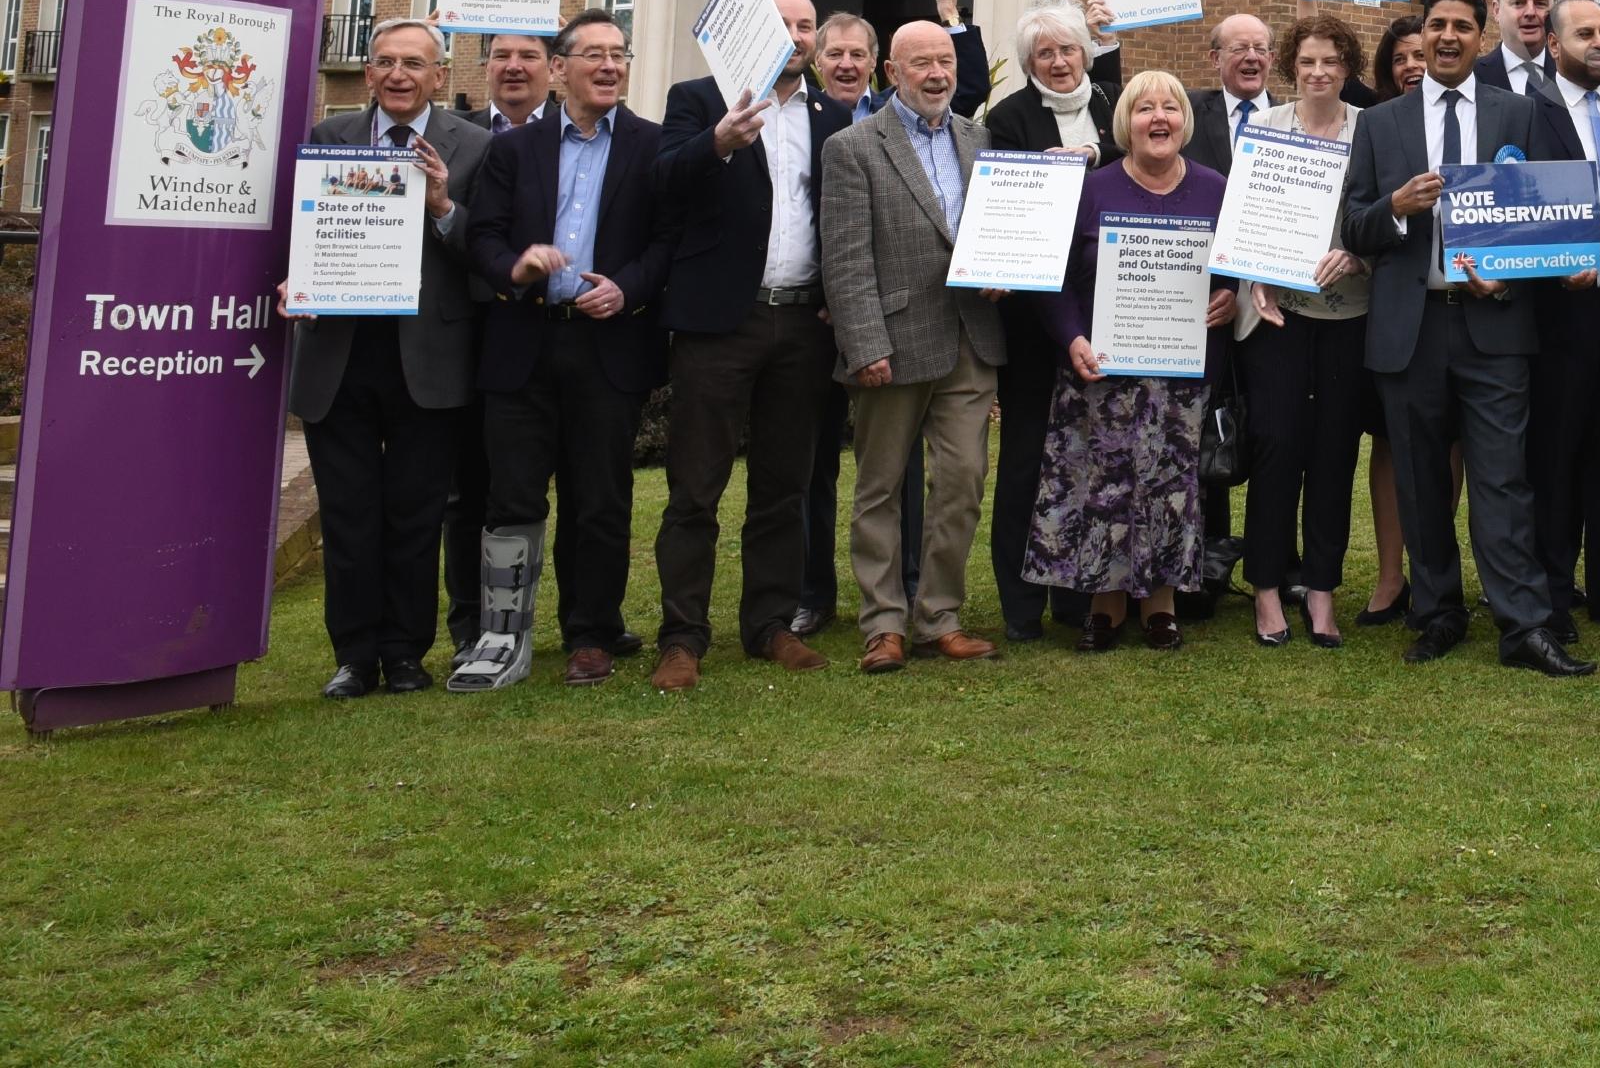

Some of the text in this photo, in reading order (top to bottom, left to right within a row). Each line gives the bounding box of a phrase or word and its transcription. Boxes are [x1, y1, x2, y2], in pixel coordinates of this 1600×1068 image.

[154, 5, 276, 32] The Royal Borough
[1257, 146, 1342, 170] 7,500 new school
[993, 167, 1048, 178] Protect the
[1253, 158, 1326, 178] places at Good
[150, 175, 251, 195] Windsor &
[991, 179, 1044, 189] vulnerable
[1249, 181, 1286, 195] schools
[1251, 169, 1333, 194] and Outstanding
[137, 194, 256, 215] Maidenhead
[1449, 191, 1495, 207] VOTE
[318, 202, 385, 212] State of the
[1451, 204, 1593, 225] CONSERVATIVE
[316, 216, 404, 226] art new leisure
[316, 229, 366, 239] facilities
[1121, 234, 1208, 248] 7,500 new school
[1119, 248, 1193, 259] places at Good
[1483, 252, 1596, 270] Conservatives
[1118, 260, 1202, 274] and Outstanding
[1117, 272, 1156, 282] schools
[312, 293, 415, 303] Vote Conservative
[86, 294, 270, 331] Town Hall
[79, 350, 223, 381] Reception
